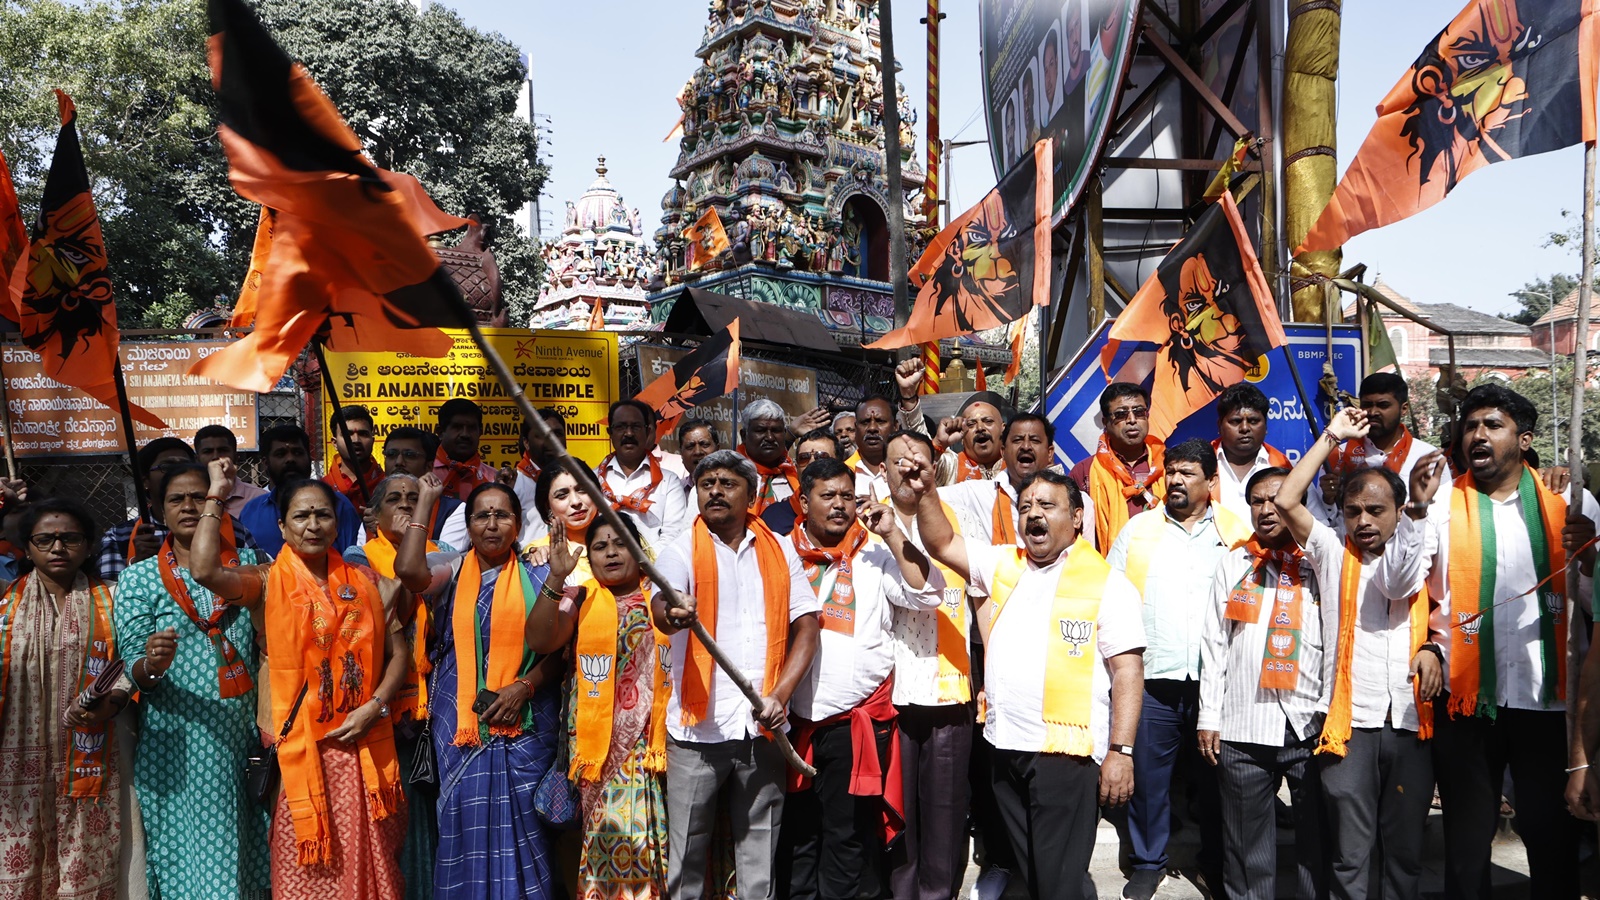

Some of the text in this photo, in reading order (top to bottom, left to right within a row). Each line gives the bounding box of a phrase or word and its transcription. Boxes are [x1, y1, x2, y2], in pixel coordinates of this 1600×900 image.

[535, 345, 563, 356] Ninth
[129, 374, 142, 387] SRI
[143, 374, 180, 387] ANJANEYA
[343, 382, 594, 399] SRI ANJANEYASWAY TEMPLE
[224, 393, 254, 407] TEMPLE
